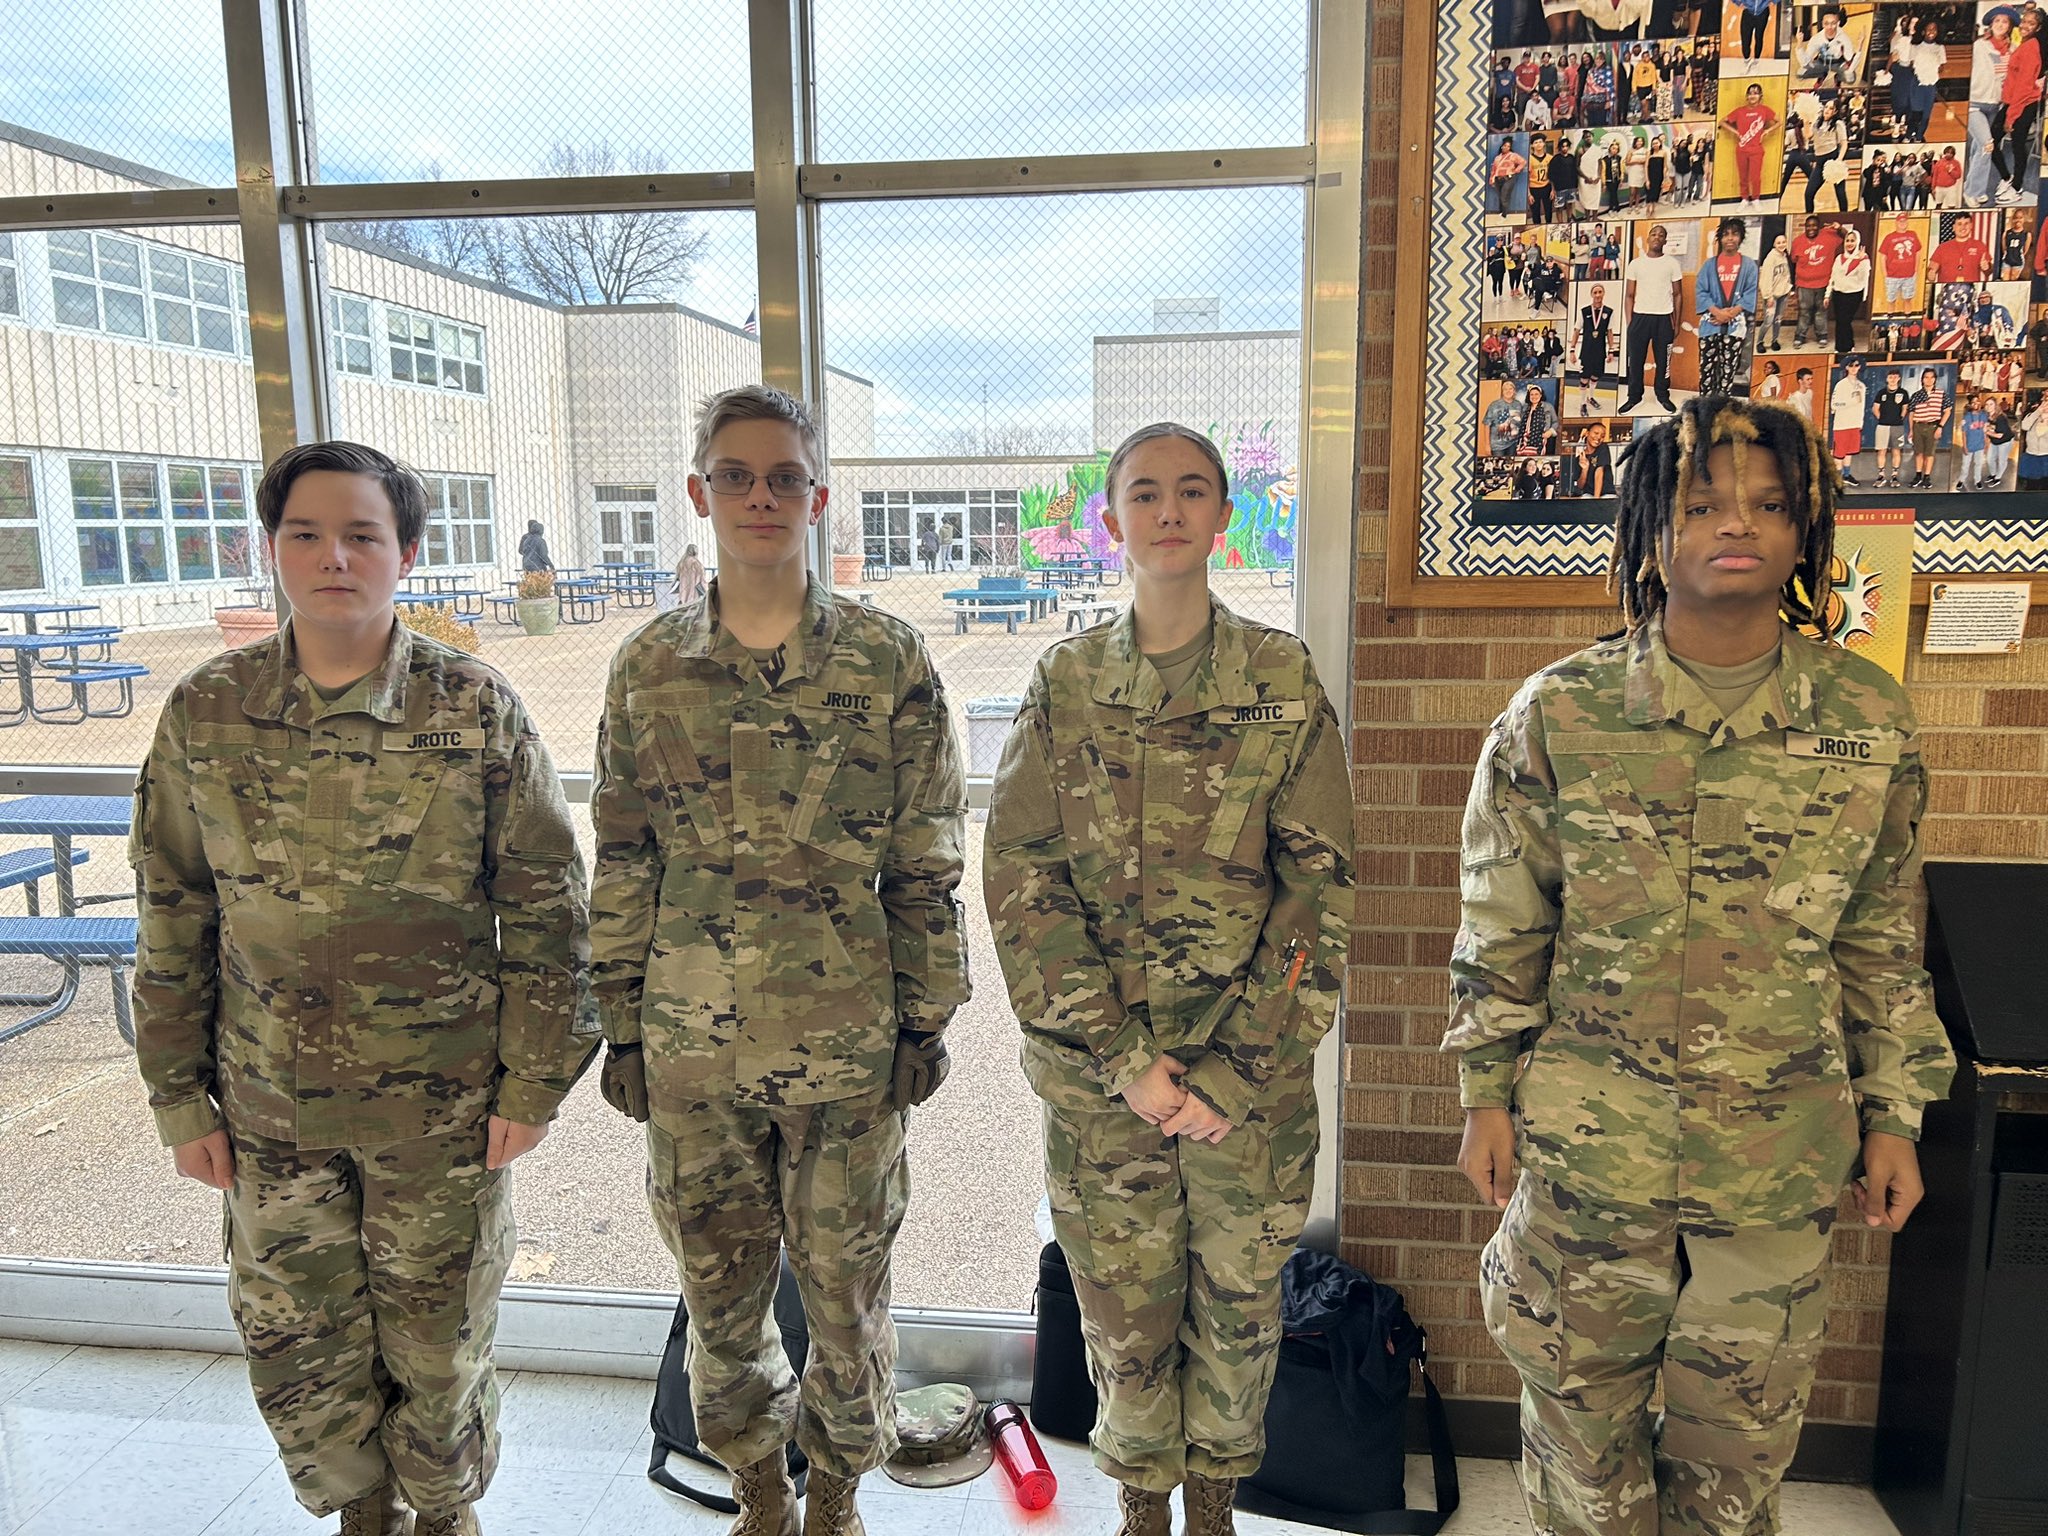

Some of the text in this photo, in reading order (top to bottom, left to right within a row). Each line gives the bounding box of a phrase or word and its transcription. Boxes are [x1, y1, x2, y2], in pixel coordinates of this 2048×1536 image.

[1537, 169, 1546, 182] 12
[821, 691, 872, 711] JROTC
[1230, 705, 1283, 723] JROTC
[406, 731, 462, 749] JROTC
[1813, 737, 1871, 759] JROTC
